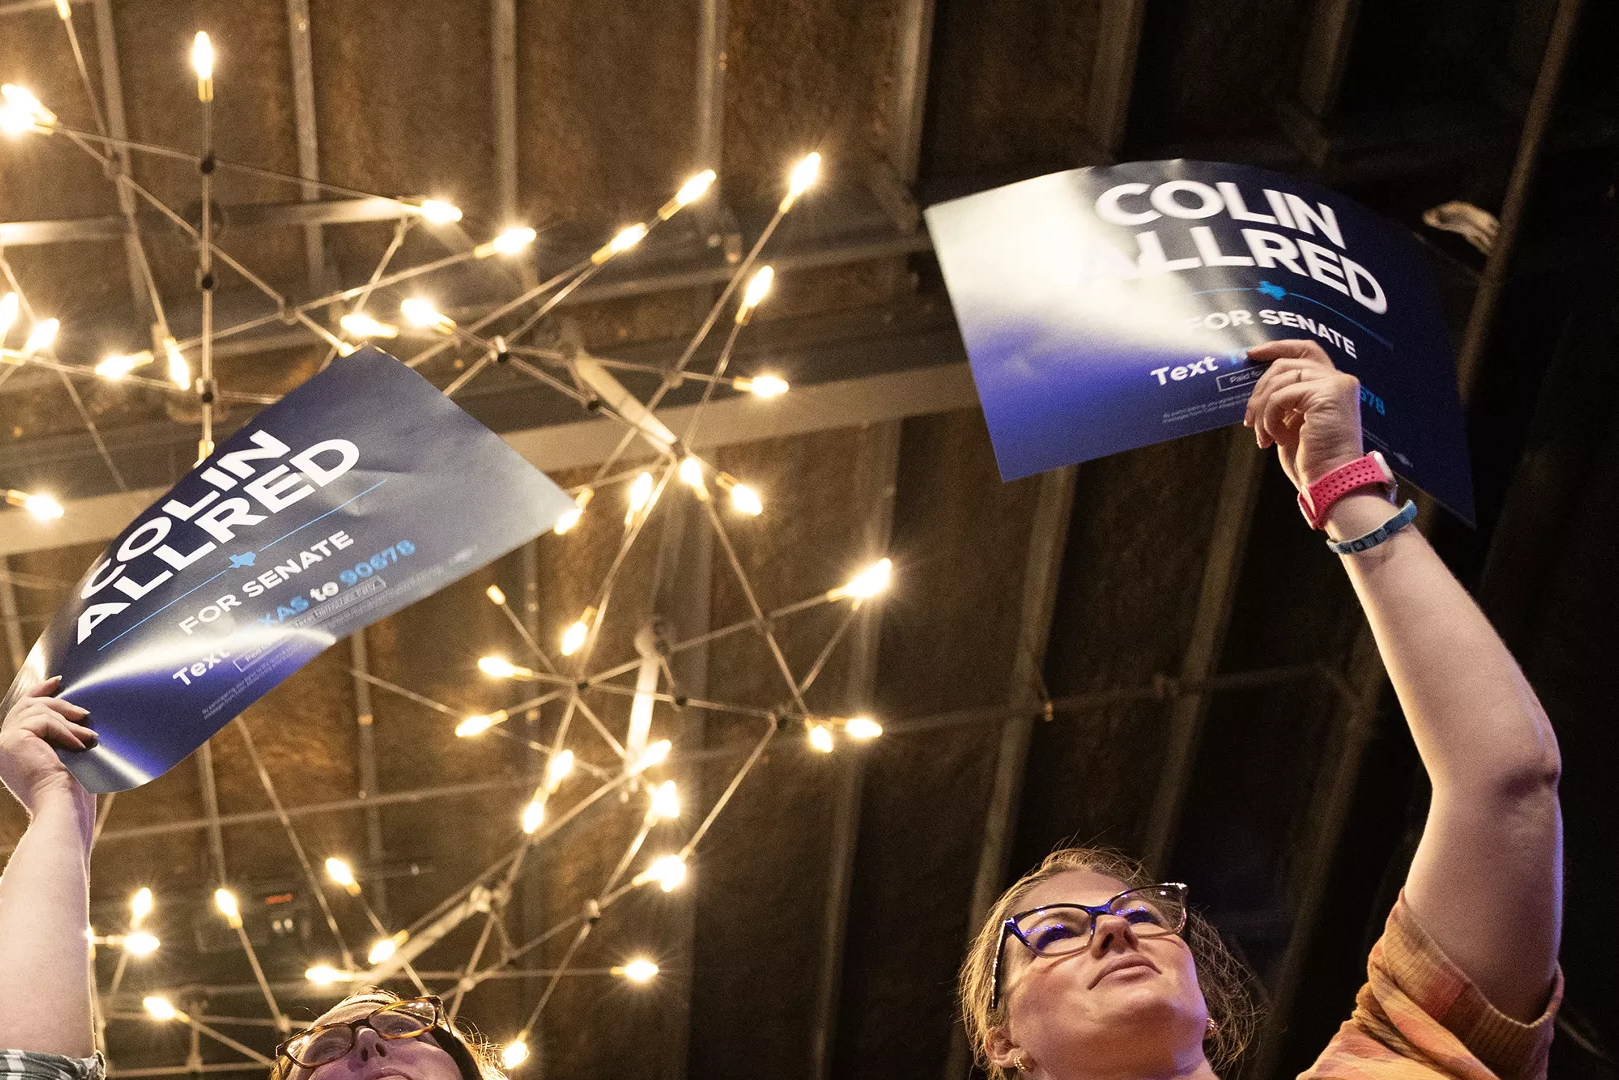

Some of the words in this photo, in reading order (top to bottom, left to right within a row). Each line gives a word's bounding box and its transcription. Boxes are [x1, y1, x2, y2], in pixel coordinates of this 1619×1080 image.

[1095, 180, 1346, 250] COLIN
[1150, 355, 1219, 386] Text
[1187, 309, 1255, 334] FOR
[1258, 309, 1358, 360] SENATE
[77, 438, 360, 645] ALLRED
[80, 429, 291, 600] COLIN
[172, 646, 231, 687] Text
[243, 596, 310, 635] XAS
[309, 581, 339, 602] to
[178, 594, 242, 636] FOR
[242, 530, 354, 598] SENATE
